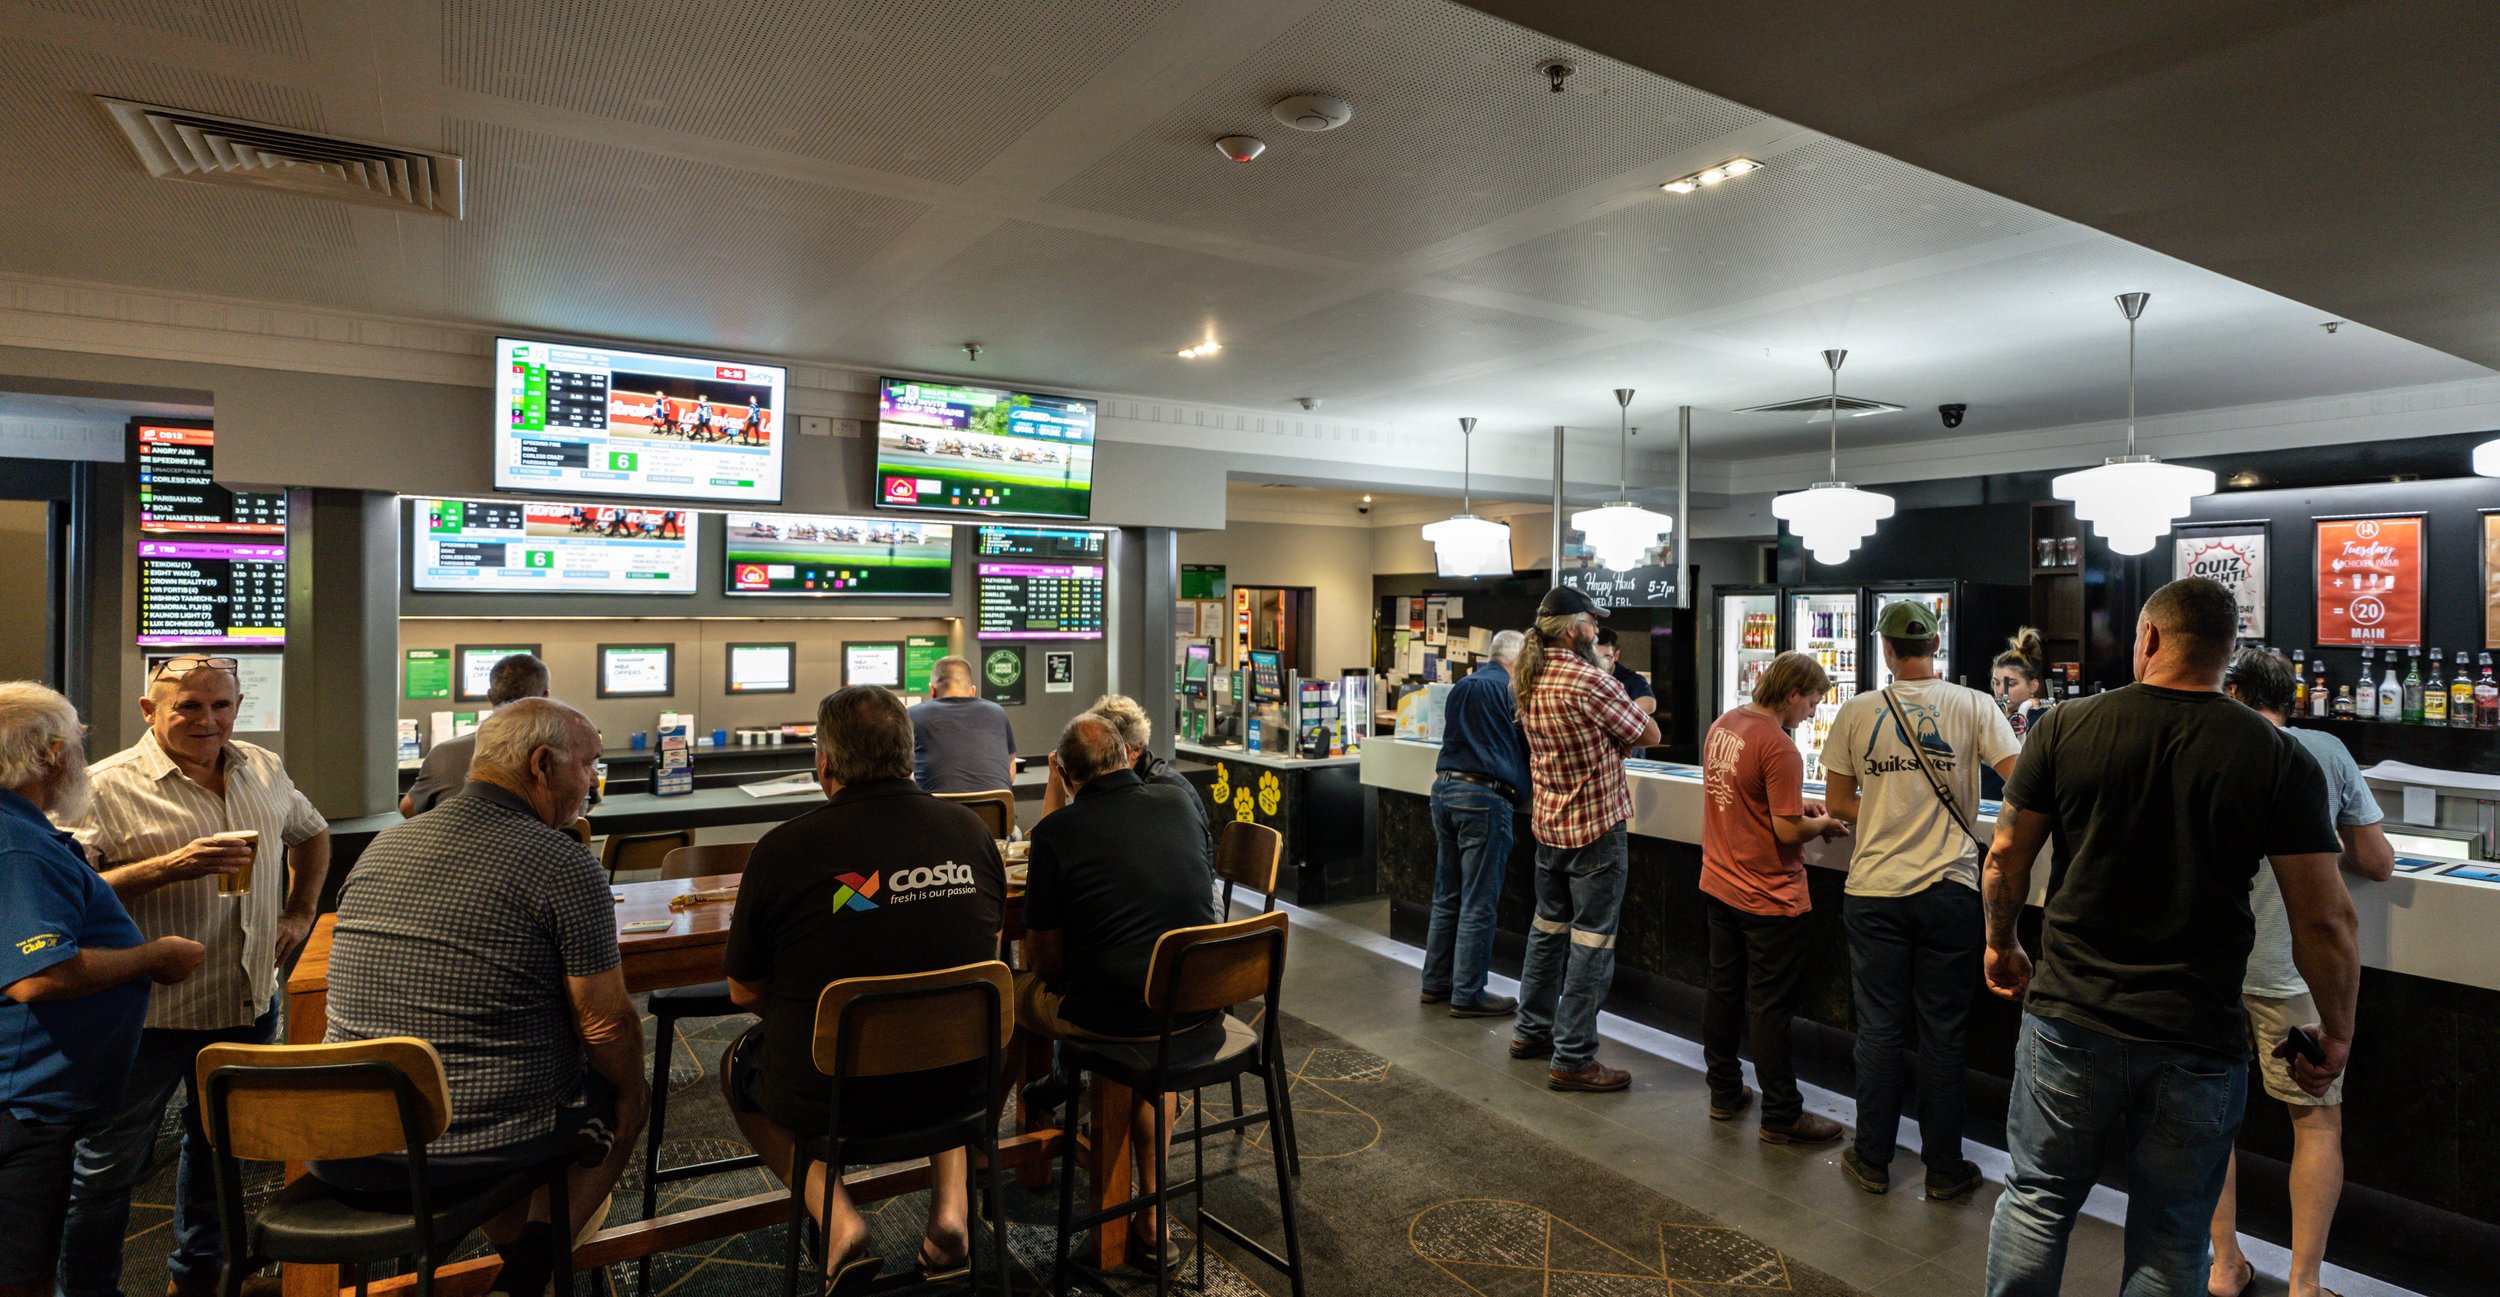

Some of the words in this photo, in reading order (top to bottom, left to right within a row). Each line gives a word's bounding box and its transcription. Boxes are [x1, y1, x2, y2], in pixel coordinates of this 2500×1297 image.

[909, 388, 916, 397] 5
[151, 447, 178, 456] ANGRY
[177, 448, 196, 456] ANN
[152, 457, 189, 465] SPEEDING
[189, 458, 207, 466] FINE
[617, 455, 630, 469] 6
[152, 476, 186, 484] CORLESS
[186, 477, 212, 486] CRAZY
[152, 495, 188, 503] PARISIAN
[187, 496, 204, 504] ROC
[152, 505, 175, 513] BOAZ
[153, 514, 166, 522] MY
[194, 516, 222, 524] BERNIE
[2342, 541, 2396, 561] Tuesday
[533, 552, 546, 566] 6
[2345, 560, 2376, 568] CHICKEN
[150, 561, 182, 569] TEIKOKU
[181, 562, 192, 570] (1)
[2195, 557, 2241, 575] QUIZ
[150, 569, 172, 577] EIGHT
[150, 578, 177, 586] CROWN
[177, 579, 208, 587] REALITY
[1584, 571, 1612, 597] Happy
[150, 595, 180, 603] NISHINO
[1615, 597, 1632, 607] FRI.
[2354, 603, 2378, 619] $20
[201, 613, 212, 621] (7)
[2351, 628, 2385, 639] MAIN
[1863, 755, 1956, 776] Quiksver
[888, 860, 975, 892] costa
[890, 893, 917, 905] fresh
[918, 889, 927, 900] is
[928, 888, 947, 898] our
[947, 886, 977, 898] passion
[22, 940, 47, 955] Club
